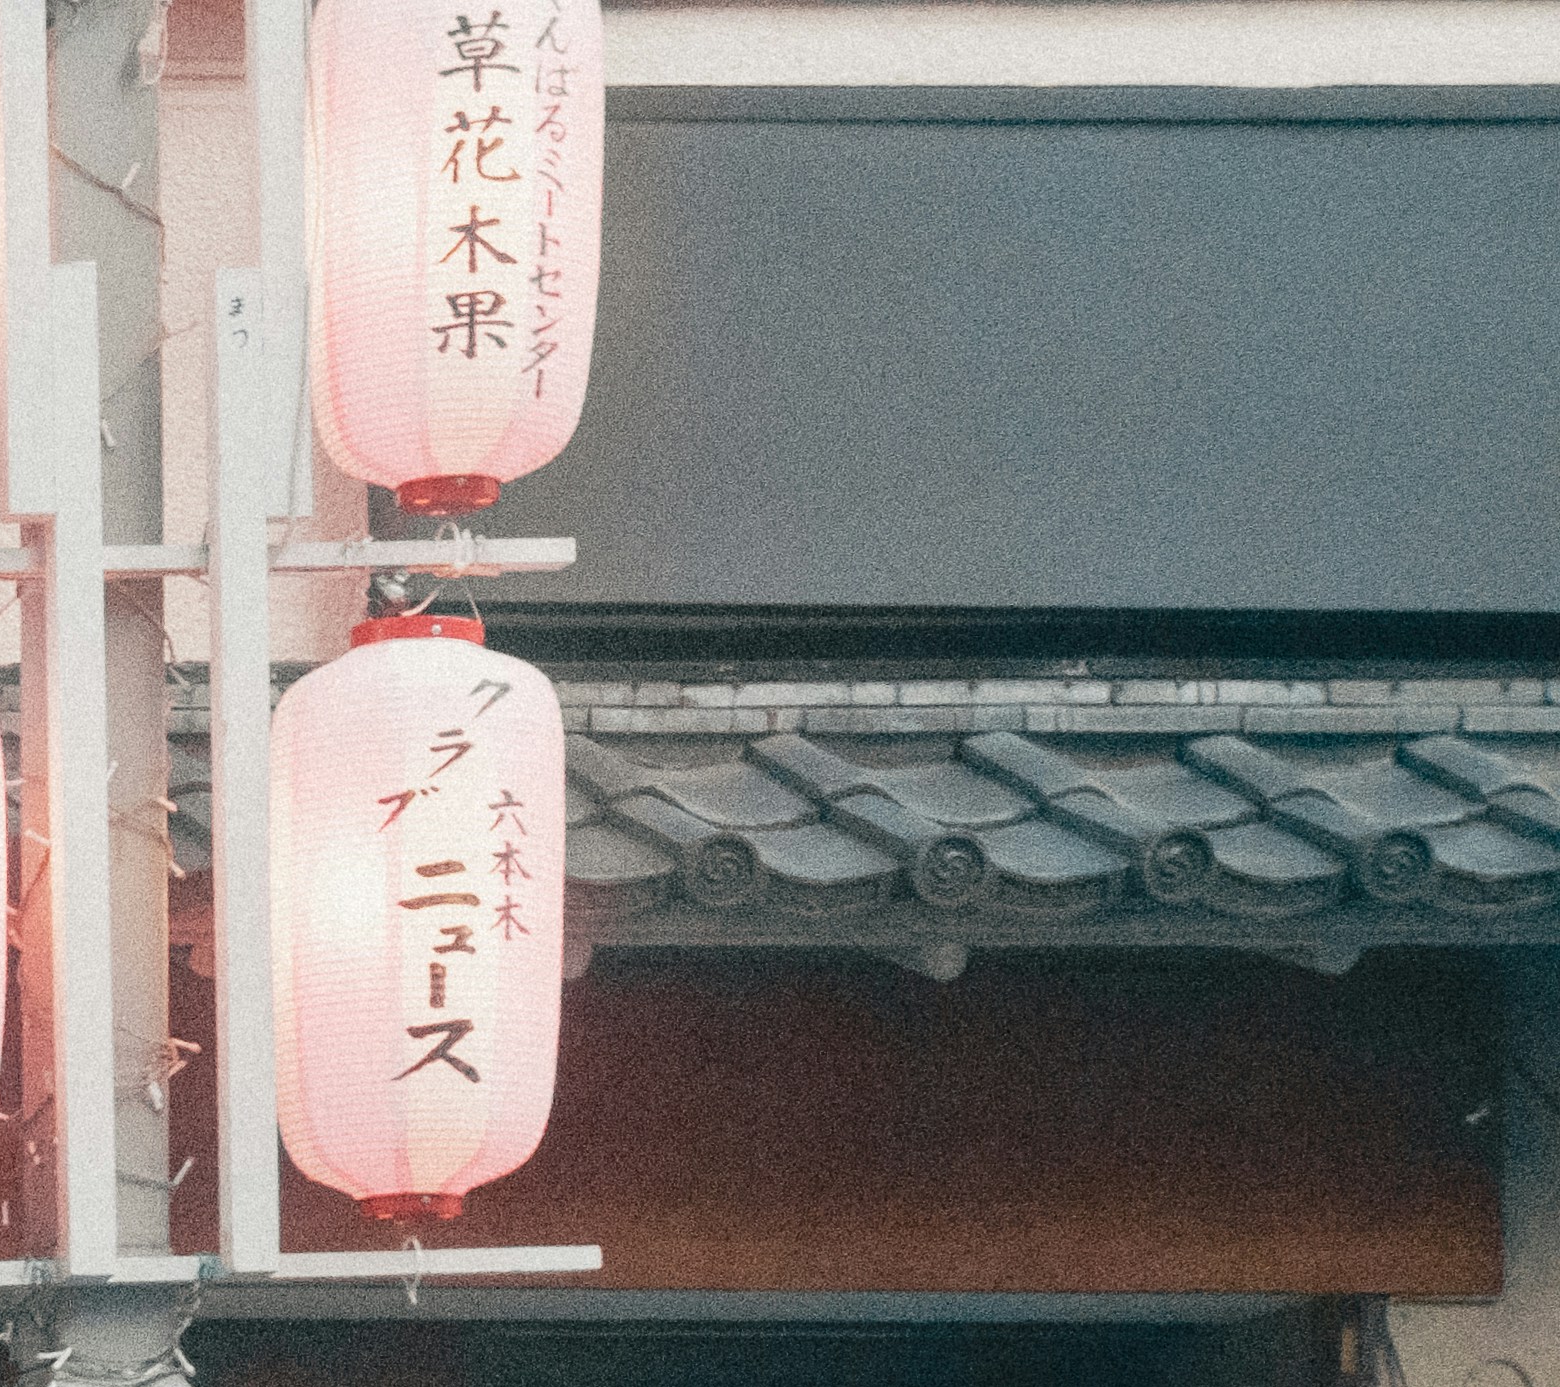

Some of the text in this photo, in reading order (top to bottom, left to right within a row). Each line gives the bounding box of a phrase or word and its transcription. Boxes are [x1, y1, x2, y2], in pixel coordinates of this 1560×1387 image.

[429, 10, 522, 360] 草花木果
[487, 789, 533, 942] 六本木
